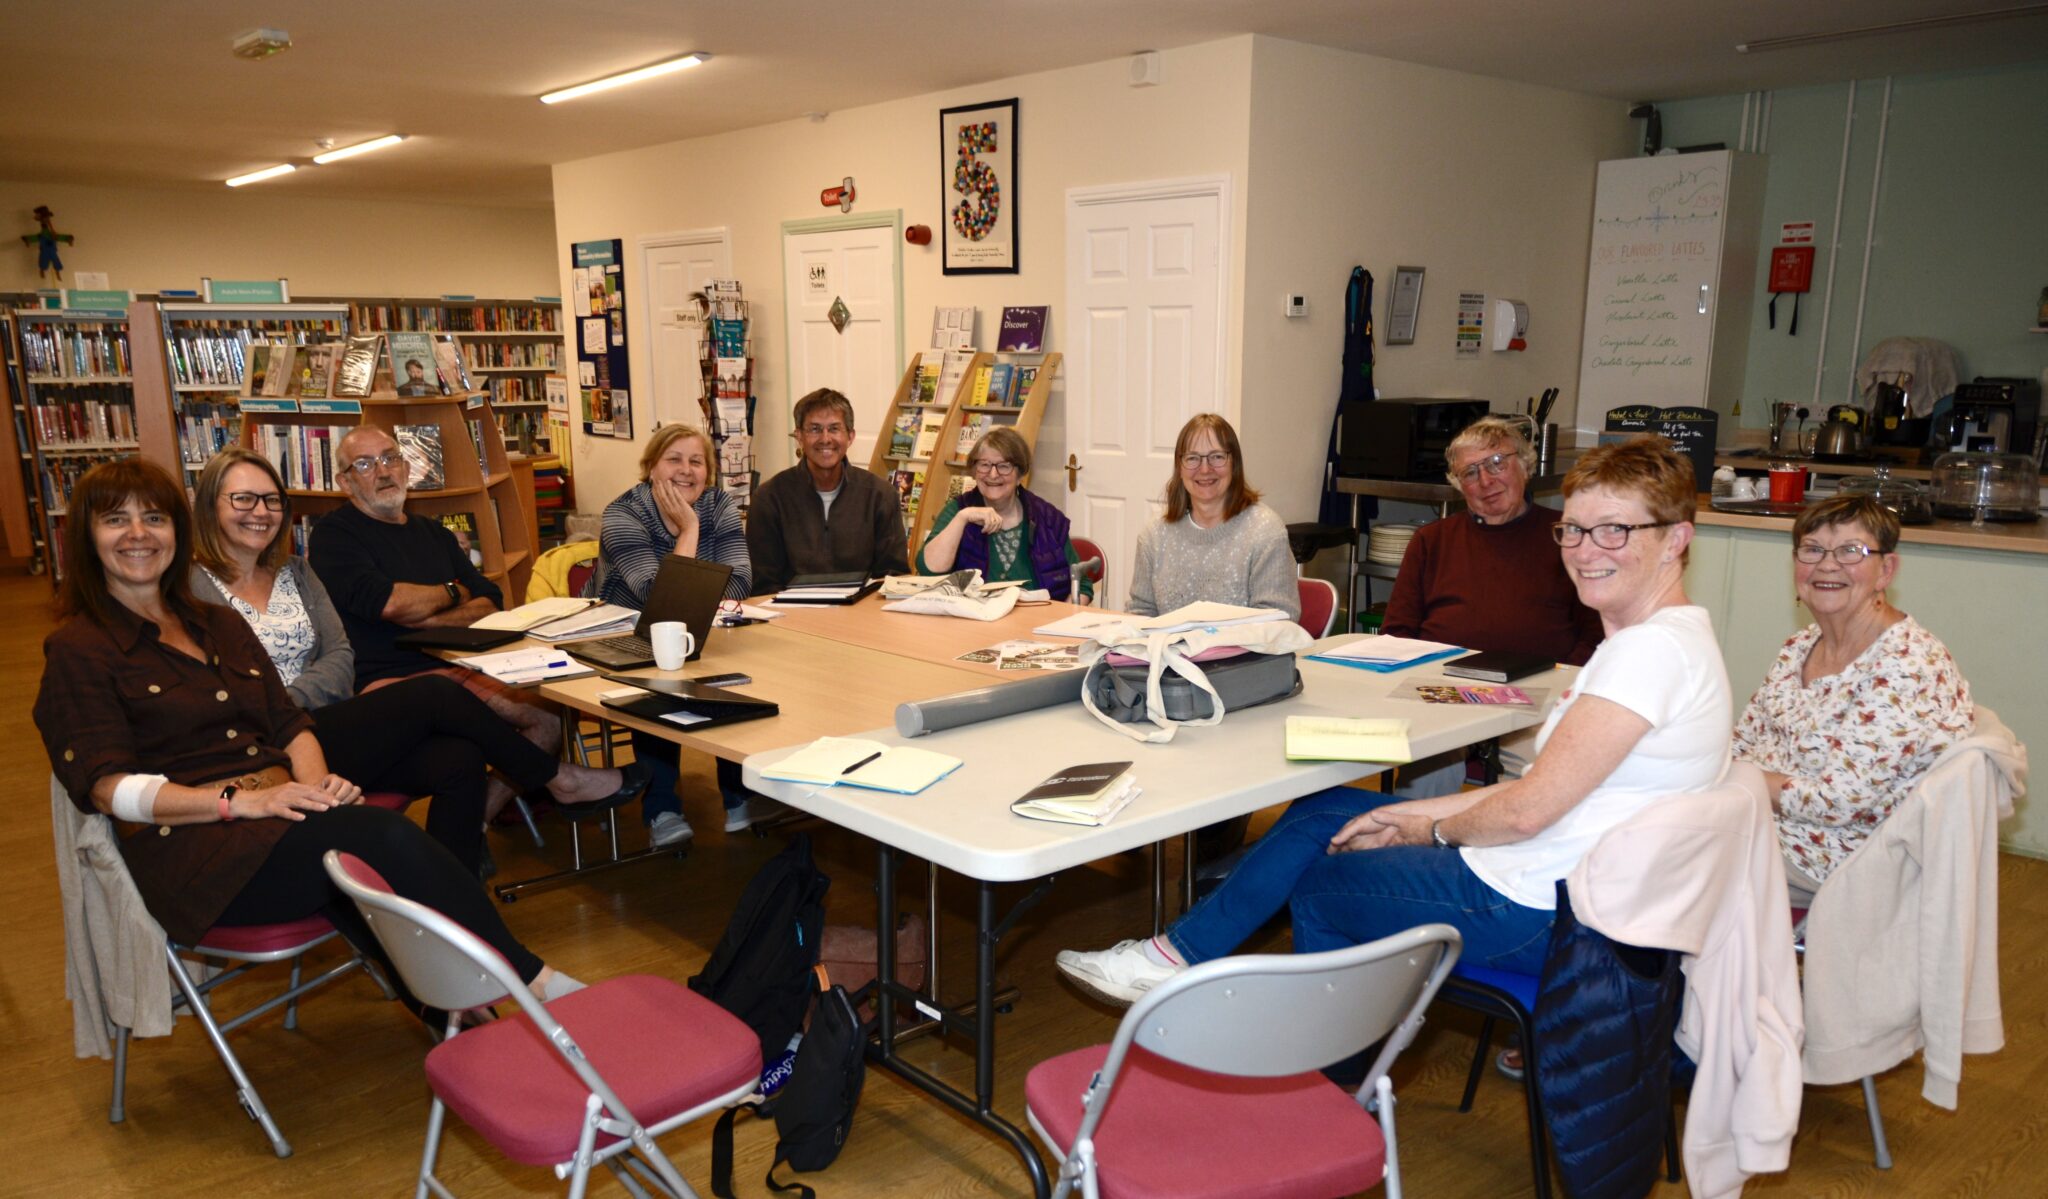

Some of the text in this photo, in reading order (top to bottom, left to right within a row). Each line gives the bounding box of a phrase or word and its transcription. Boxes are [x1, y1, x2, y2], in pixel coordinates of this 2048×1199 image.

[952, 121, 1000, 242] 5
[1672, 241, 1705, 256] LATTES
[1652, 273, 1678, 285] Latte
[1641, 293, 1665, 302] Latte
[1647, 311, 1680, 321] Latte
[1004, 321, 1029, 329] Discover
[396, 335, 421, 343] DAVID
[1652, 335, 1679, 347] Latte
[1670, 356, 1692, 366] Latte
[443, 515, 468, 524] ALAN
